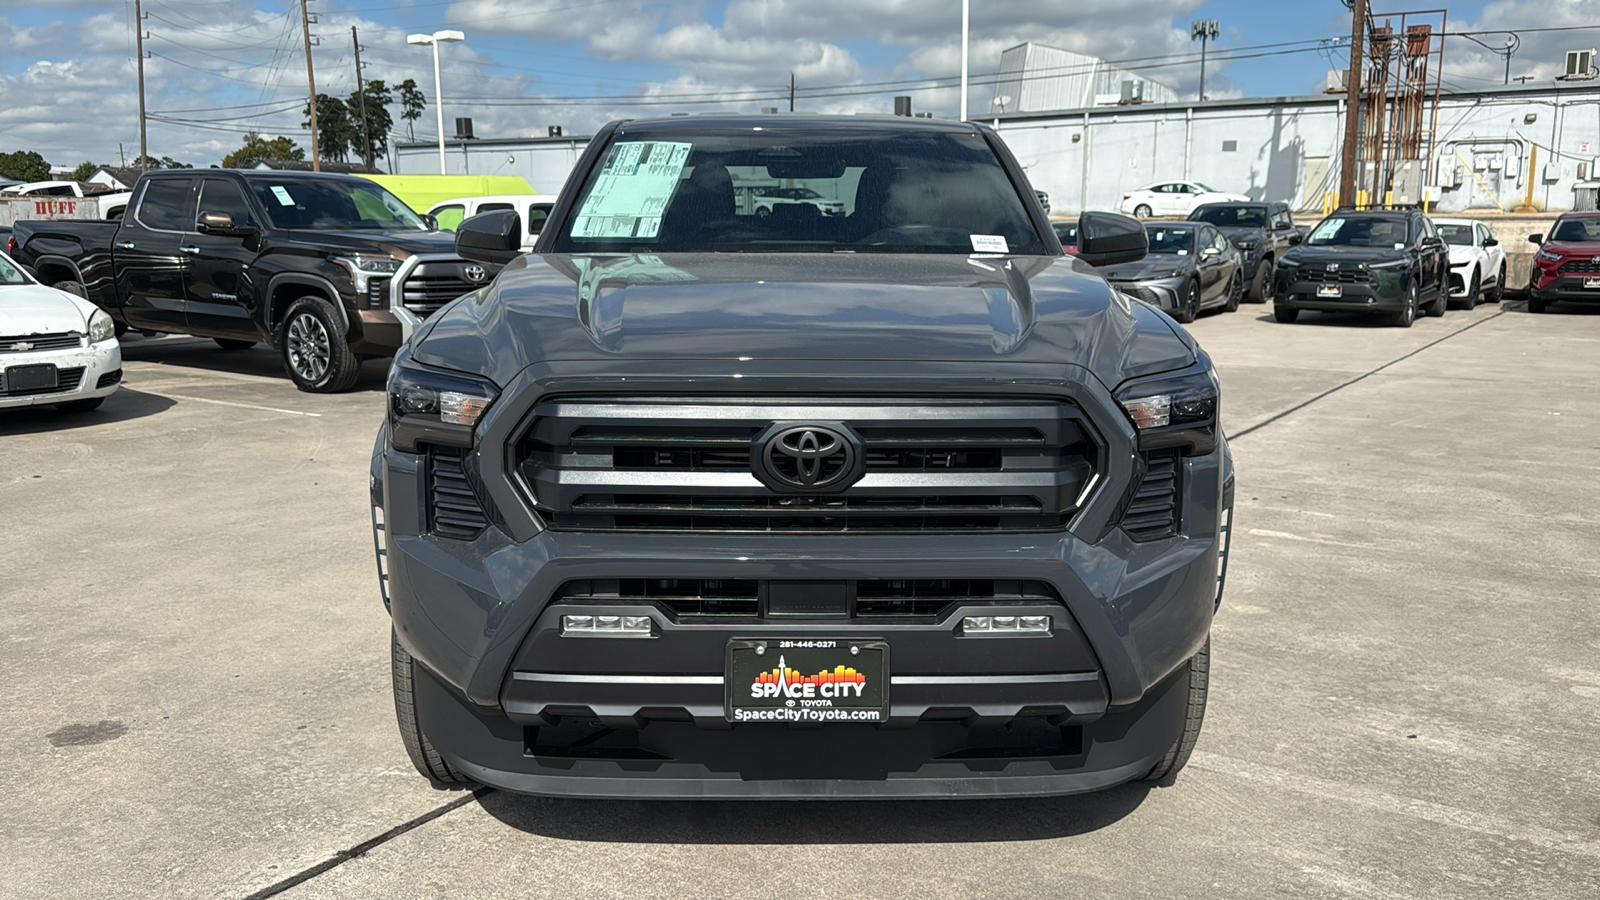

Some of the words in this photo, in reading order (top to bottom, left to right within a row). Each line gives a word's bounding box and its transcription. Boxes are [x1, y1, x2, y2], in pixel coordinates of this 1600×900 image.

[35, 201, 77, 216] HUFF
[750, 682, 816, 698] SPACE
[820, 682, 867, 698] CITY
[734, 708, 880, 722] SpaceCityToyota.com
